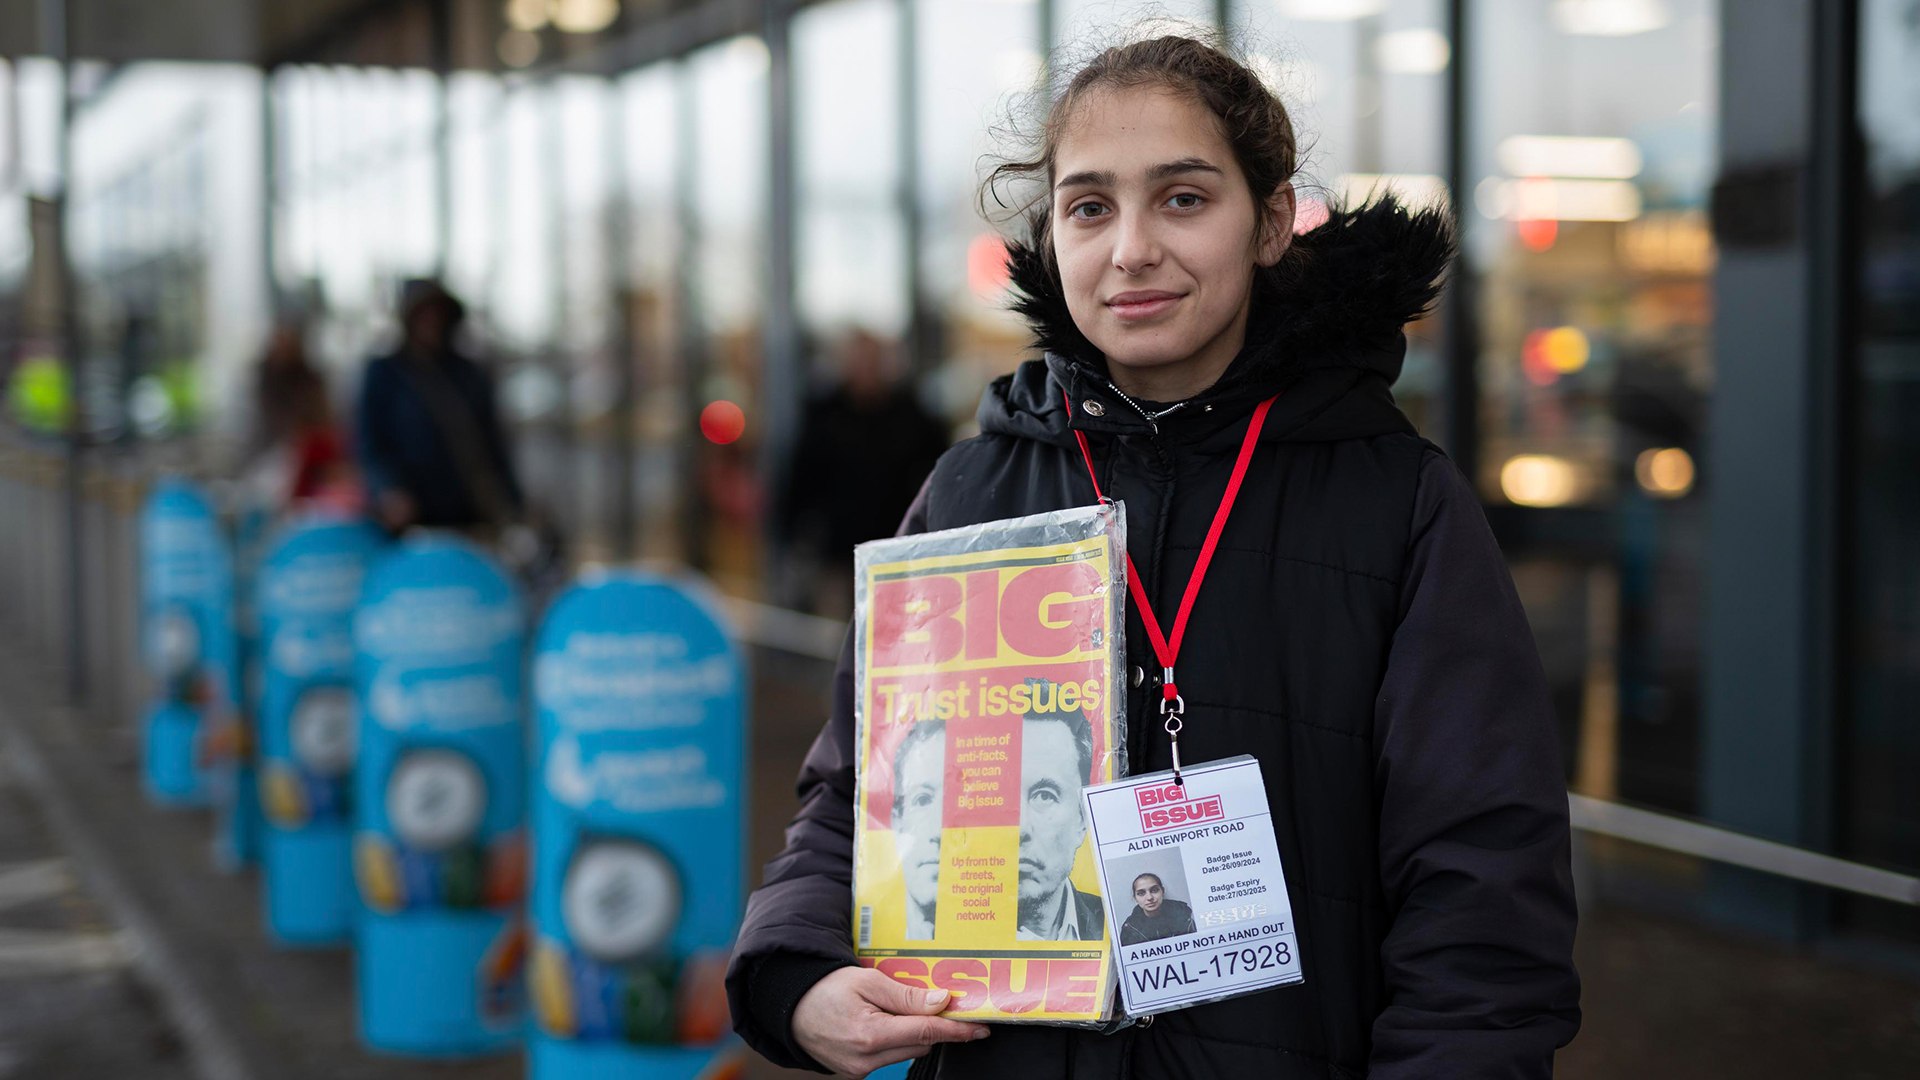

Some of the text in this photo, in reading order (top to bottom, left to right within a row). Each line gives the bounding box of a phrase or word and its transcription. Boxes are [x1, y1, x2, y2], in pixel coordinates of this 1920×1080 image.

[872, 562, 1105, 669] BIG
[877, 677, 1100, 723] Trust issues
[956, 733, 1010, 748] In a time of
[957, 749, 1008, 763] anti-facts,
[962, 766, 1001, 780] you can
[963, 780, 998, 792] believe
[958, 795, 1004, 810] Big Issue
[1139, 785, 1184, 807] BIG
[1143, 800, 1221, 829] ISSUE
[1128, 822, 1245, 852] ALDI NEWPORT ROAD
[951, 856, 1005, 869] Up from the
[1206, 850, 1252, 864] Badge Issue
[1202, 857, 1261, 874] Date:26/09/2024
[960, 870, 996, 881] streets,
[952, 882, 1003, 896] the original
[1210, 878, 1260, 893] Badge Expiry
[1208, 885, 1267, 903] Date:27/03/2025
[962, 897, 990, 907] social
[956, 910, 996, 920] network
[1131, 922, 1285, 960] A HAND UP NOT A HAND OUT
[1132, 941, 1292, 993] WAL-17928
[858, 957, 1102, 1015] SSUE
